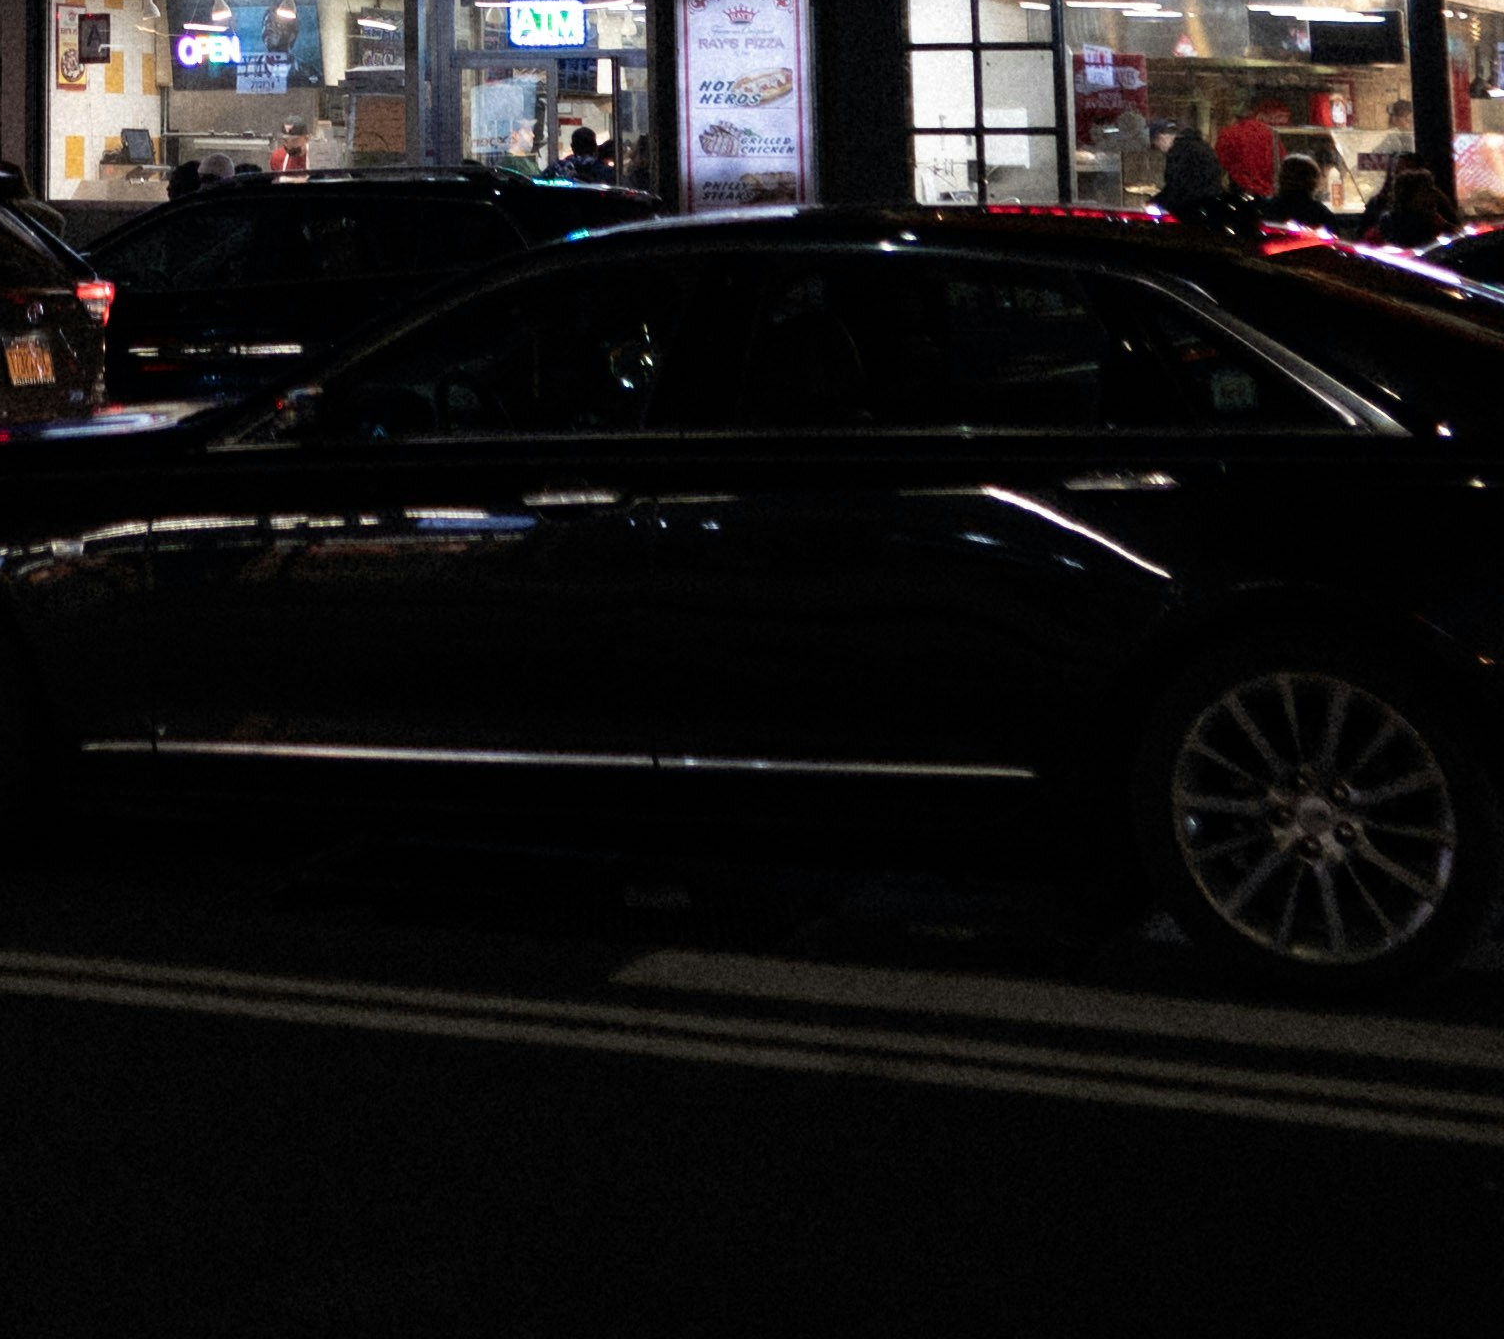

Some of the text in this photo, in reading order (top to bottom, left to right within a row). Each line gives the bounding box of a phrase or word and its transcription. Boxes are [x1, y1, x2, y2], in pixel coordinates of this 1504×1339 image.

[516, 7, 577, 38] ATM
[698, 36, 785, 50] RAY'S PIZZA
[178, 34, 241, 66] OPEN
[699, 80, 735, 92] HOT
[699, 93, 762, 105] HEROS
[741, 137, 792, 146] GRILLED
[741, 146, 796, 155] CHICKEN
